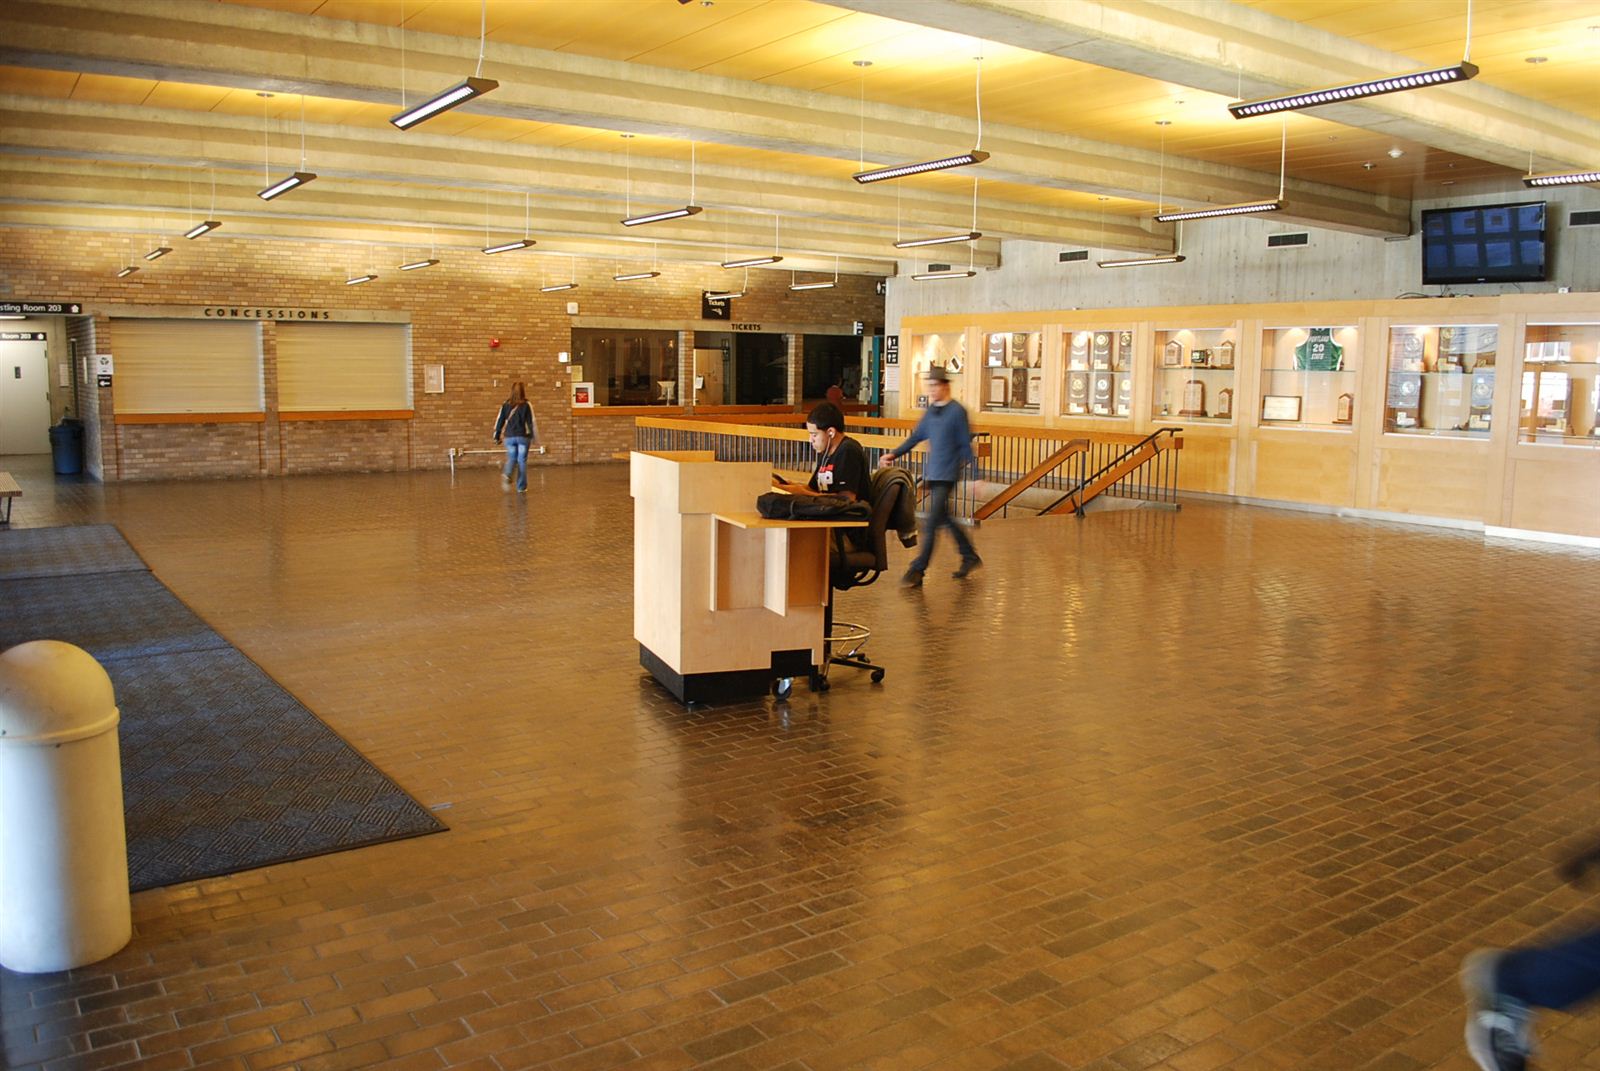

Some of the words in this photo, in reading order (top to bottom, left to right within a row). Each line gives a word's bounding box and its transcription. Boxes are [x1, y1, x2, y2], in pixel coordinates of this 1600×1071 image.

[708, 299, 725, 307] Tickets
[23, 304, 46, 312] Room
[48, 304, 62, 312] 203
[204, 308, 329, 319] CONCESSIONS
[731, 323, 761, 331] TICKETS
[1313, 344, 1325, 352] 20
